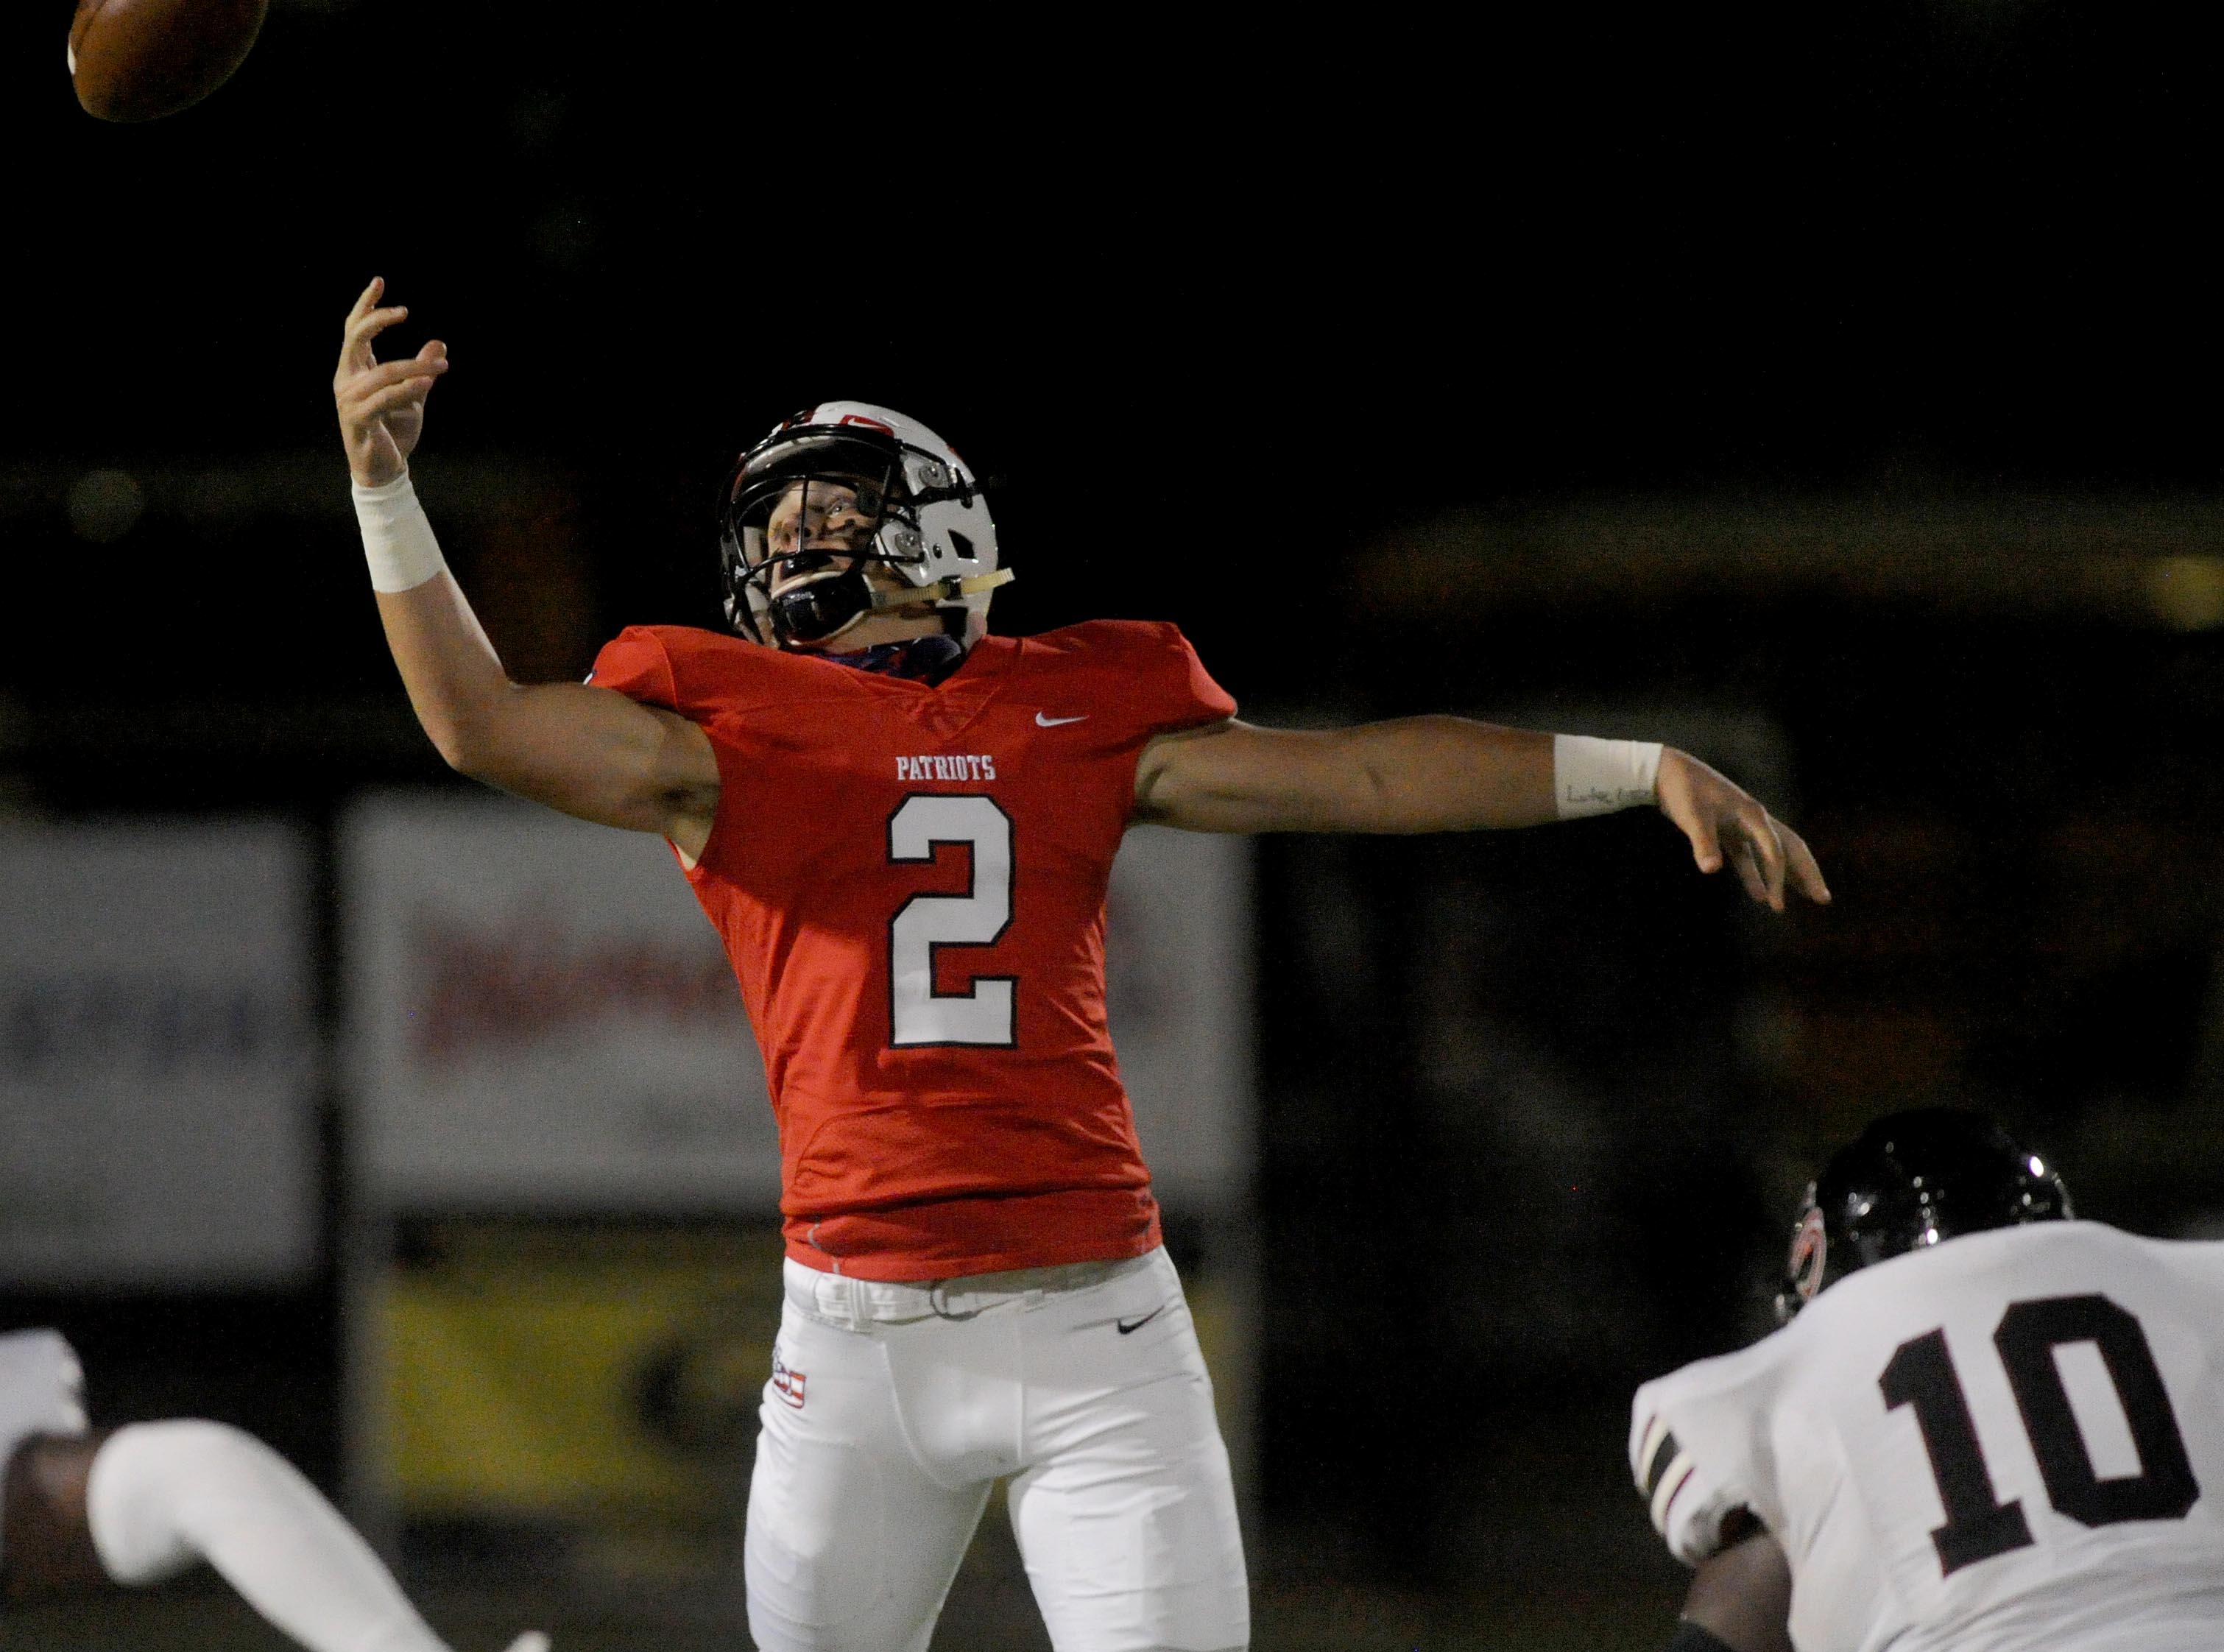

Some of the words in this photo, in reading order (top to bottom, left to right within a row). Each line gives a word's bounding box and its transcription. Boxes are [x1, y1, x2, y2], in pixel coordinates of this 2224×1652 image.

[895, 755, 996, 781] PATRIOTS
[887, 791, 1018, 1048] 2
[1877, 1292, 2200, 1581] 10
